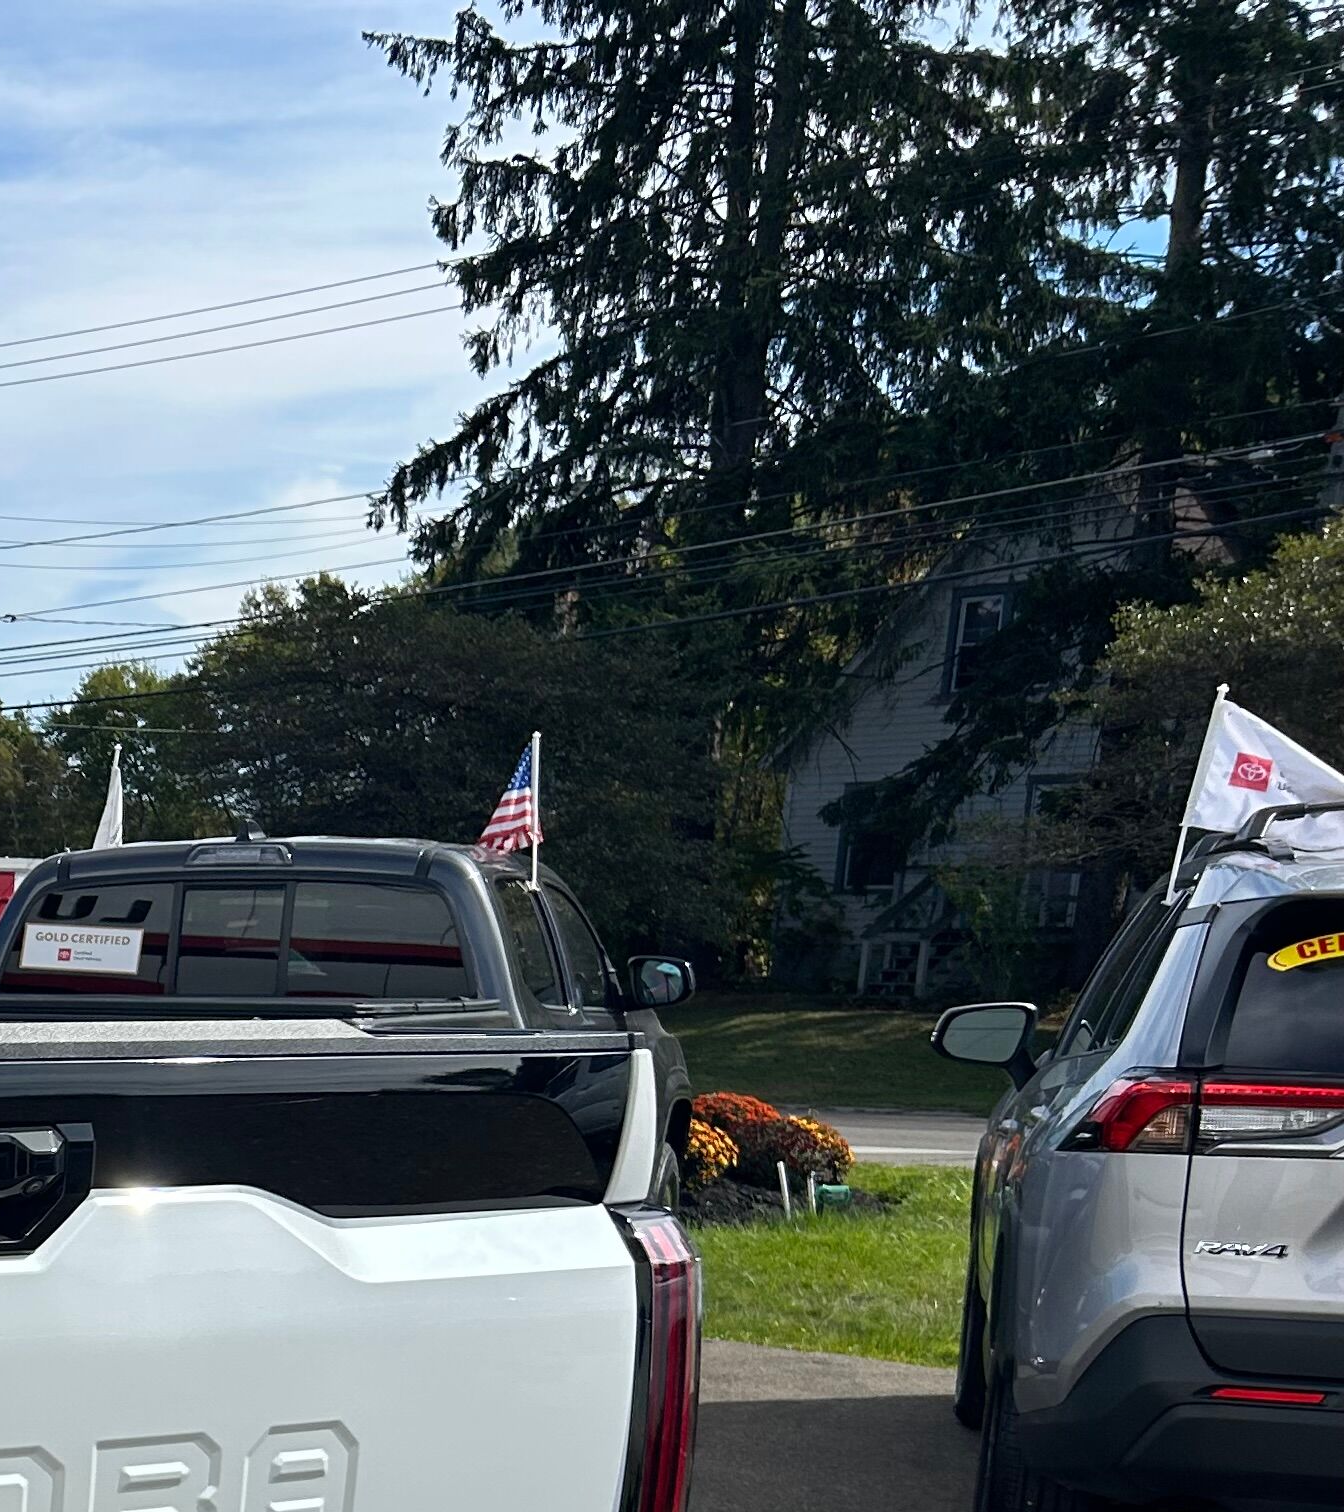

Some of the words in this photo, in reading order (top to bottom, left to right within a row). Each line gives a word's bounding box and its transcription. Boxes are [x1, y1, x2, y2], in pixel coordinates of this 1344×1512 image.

[35, 931, 69, 943] GOLD
[70, 933, 131, 946] CERTIFIED
[1193, 1240, 1289, 1259] RAV4
